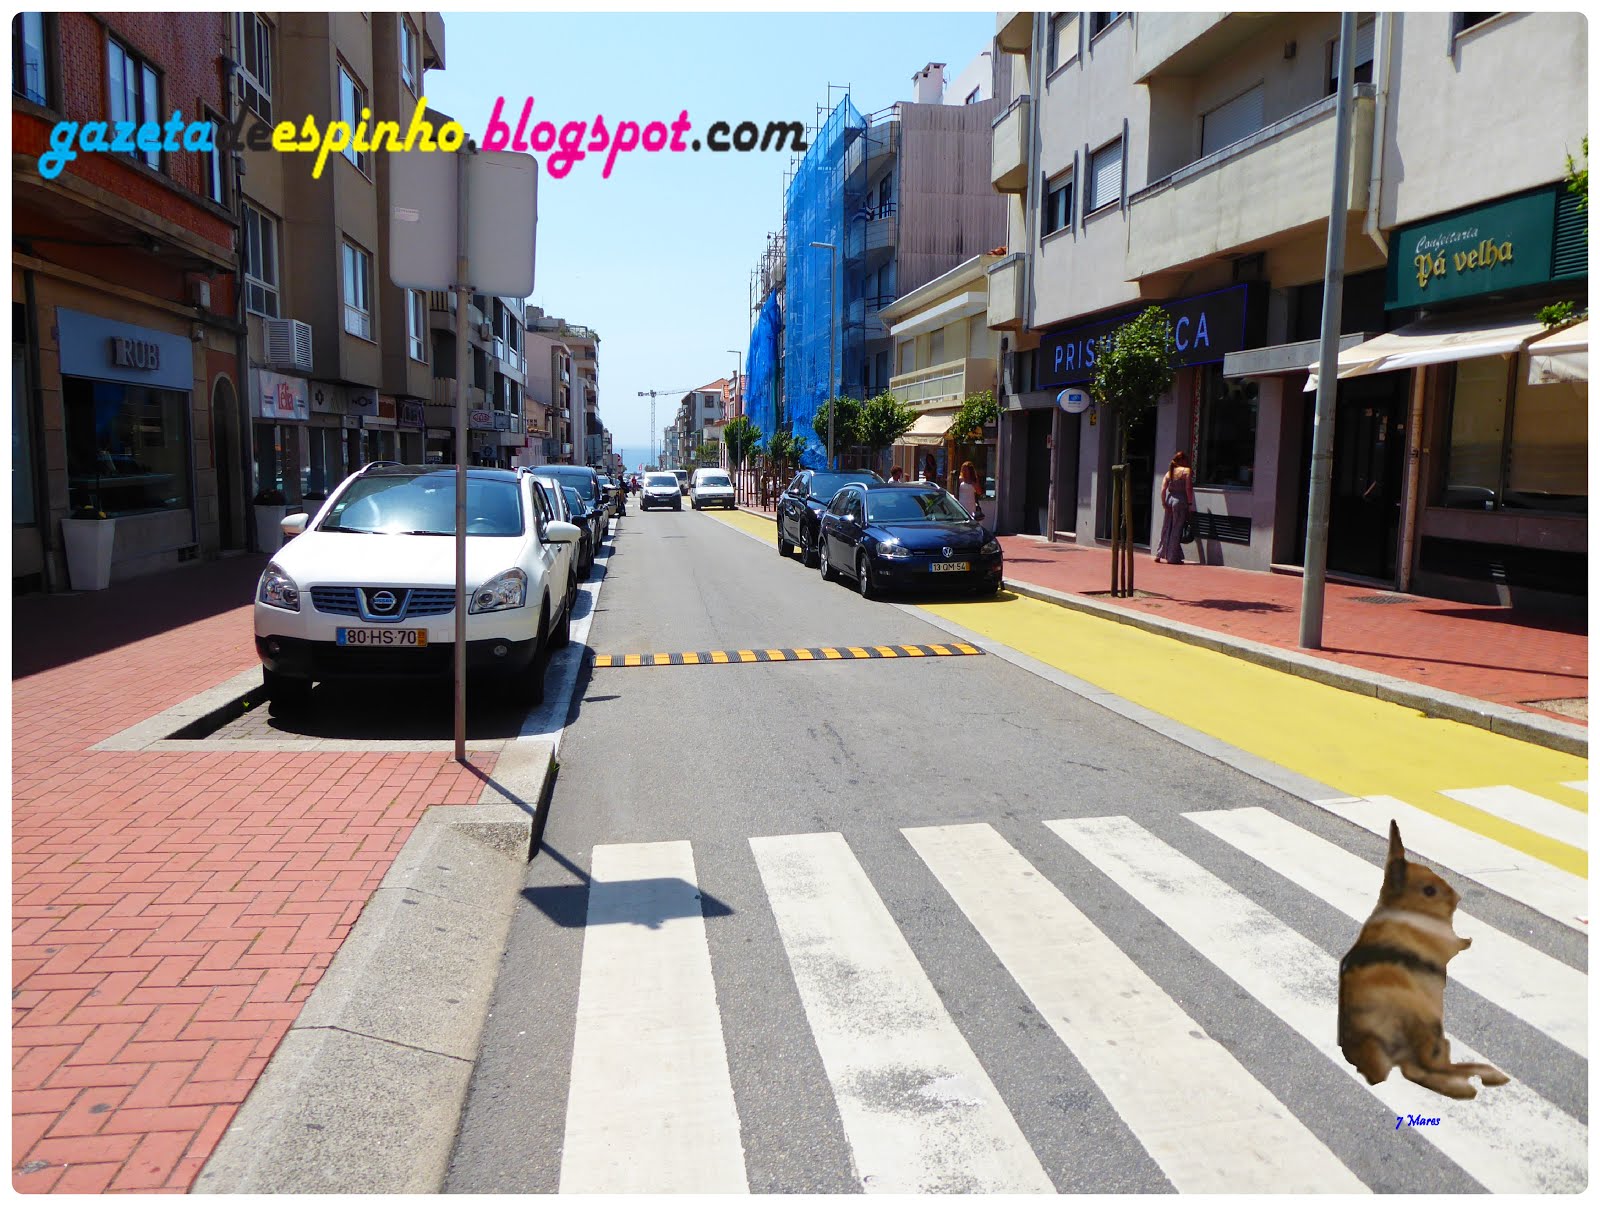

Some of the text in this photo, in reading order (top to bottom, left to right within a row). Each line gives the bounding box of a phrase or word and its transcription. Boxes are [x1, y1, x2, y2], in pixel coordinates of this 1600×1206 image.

[1414, 237, 1514, 289] Pá velha
[1054, 311, 1210, 373] PRISICA
